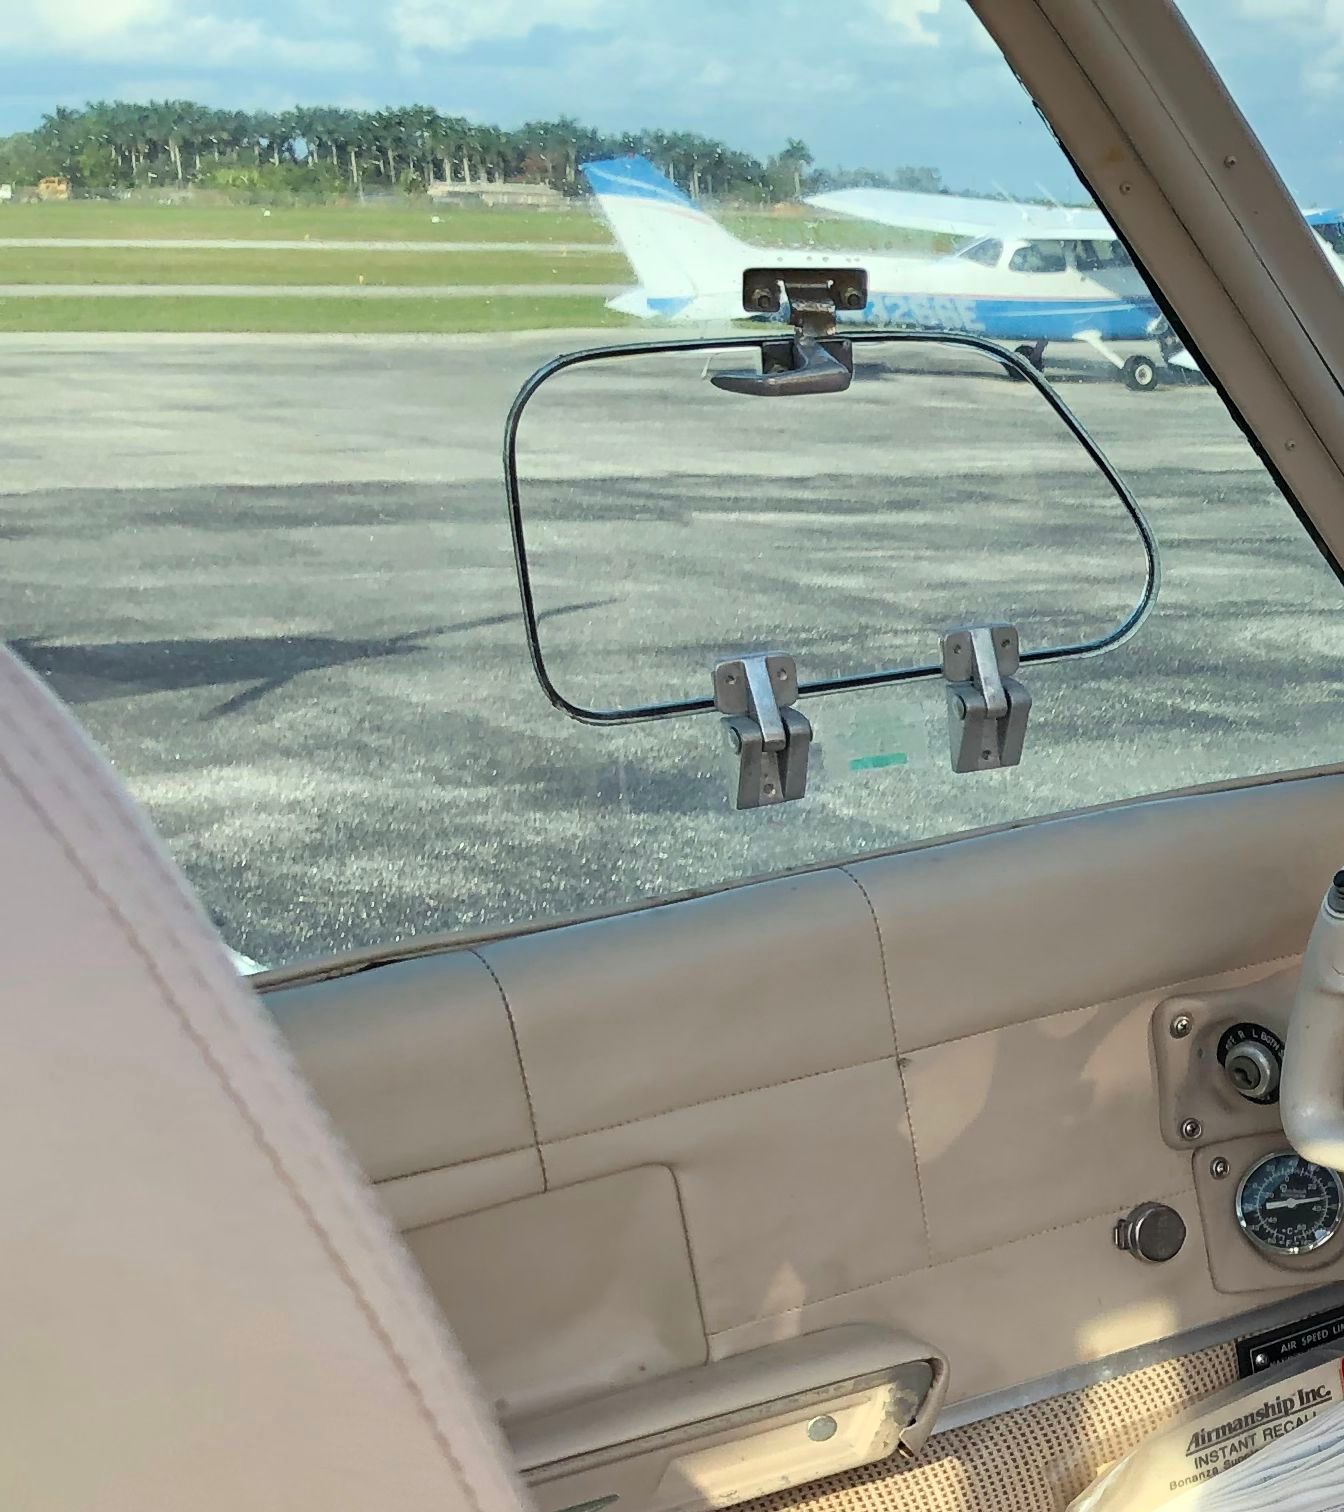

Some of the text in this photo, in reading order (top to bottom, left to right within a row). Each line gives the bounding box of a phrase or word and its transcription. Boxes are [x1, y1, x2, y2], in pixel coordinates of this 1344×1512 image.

[1260, 1032, 1280, 1051] BOTH
[1280, 1340, 1297, 1354] AIR
[1301, 1329, 1329, 1346] SPEED
[1186, 1395, 1295, 1452] Airmanship
[1297, 1384, 1332, 1405] Inc.
[1194, 1432, 1257, 1470] INSTANT
[1169, 1466, 1219, 1491] Bonanza
